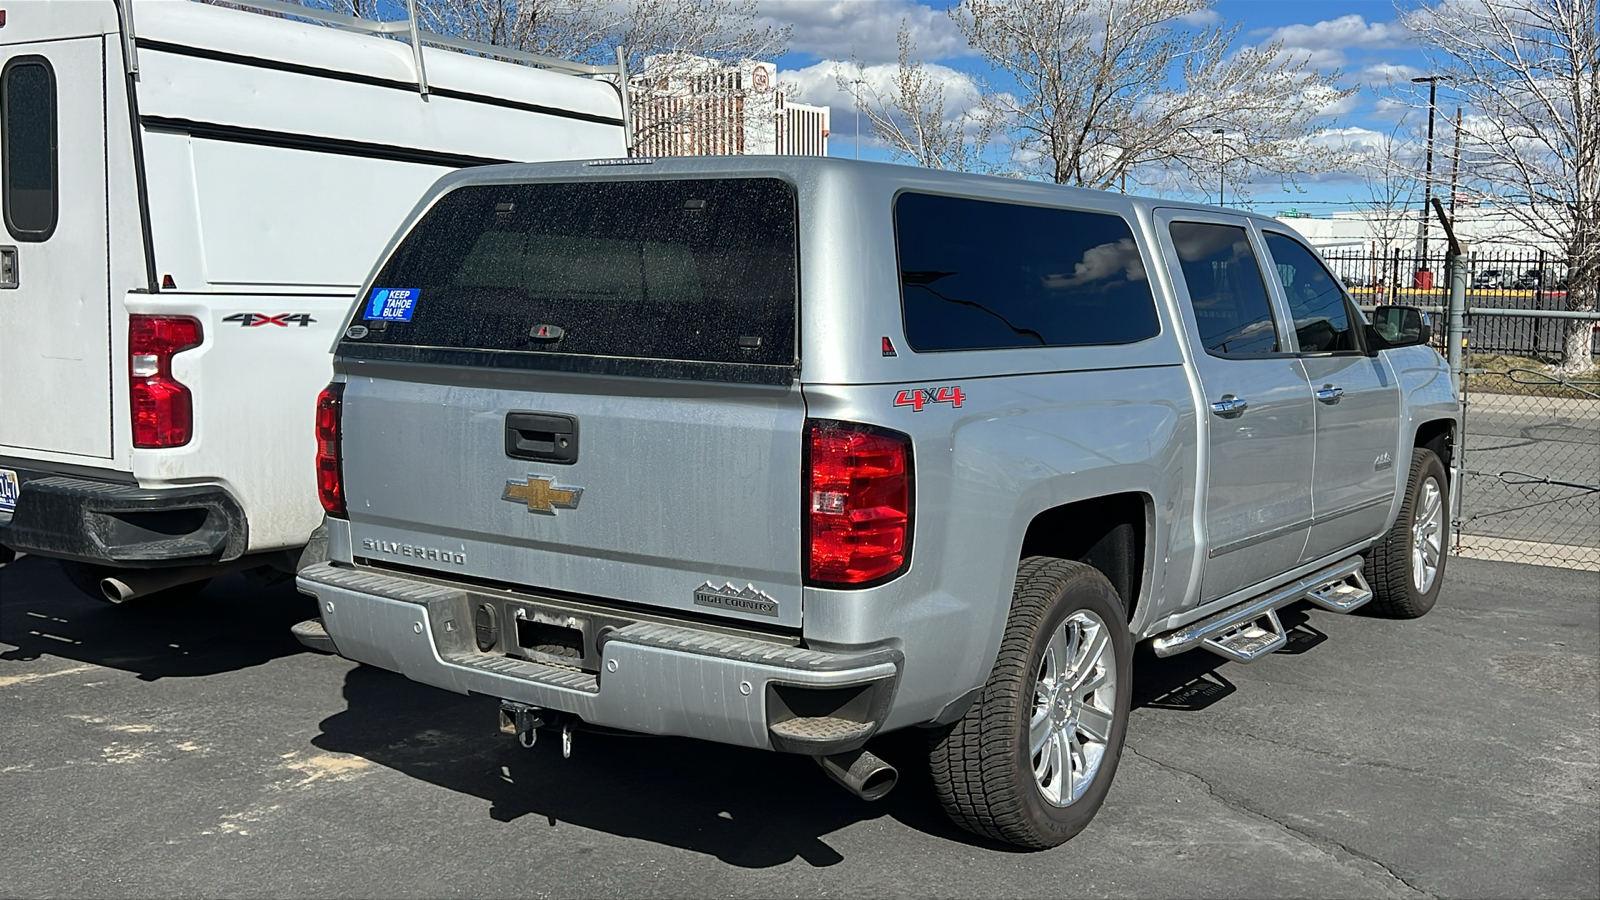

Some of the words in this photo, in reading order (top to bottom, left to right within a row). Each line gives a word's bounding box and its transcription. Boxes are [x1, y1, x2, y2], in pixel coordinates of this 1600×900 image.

[389, 290, 411, 299] KEEP
[386, 299, 413, 309] TAHOE
[382, 308, 405, 317] BLUE
[362, 537, 467, 566] SILVERADO
[696, 593, 722, 604] HIGH
[724, 597, 775, 612] COUNTRY
